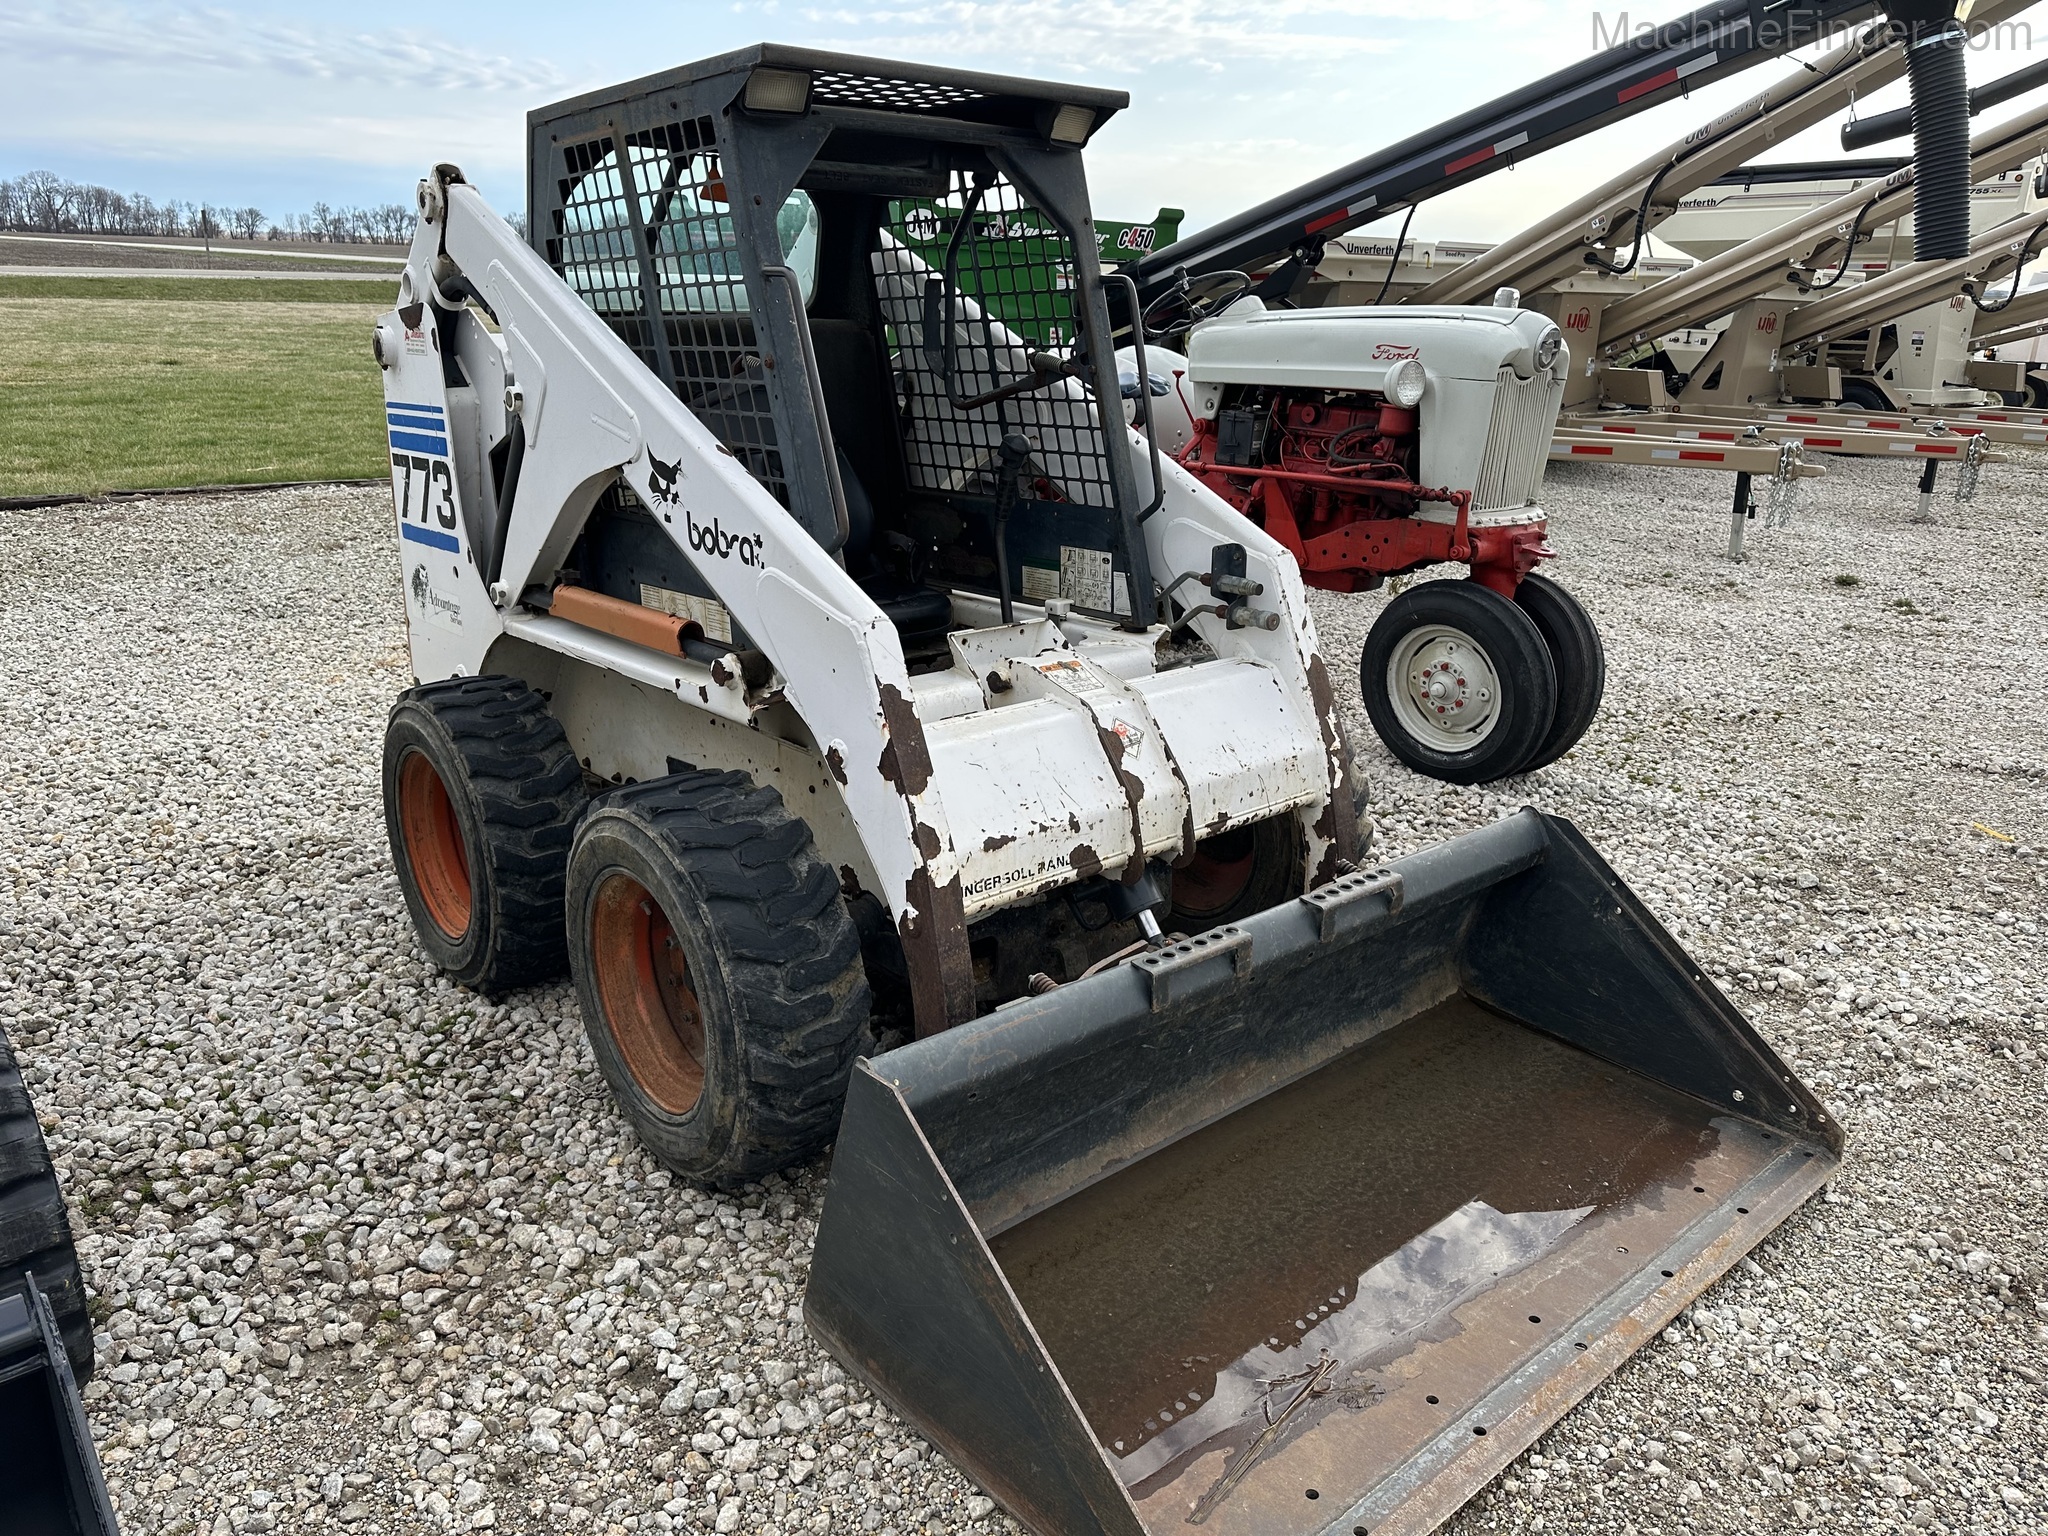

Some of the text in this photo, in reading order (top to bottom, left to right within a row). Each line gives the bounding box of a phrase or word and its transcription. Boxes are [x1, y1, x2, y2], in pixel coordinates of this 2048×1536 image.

[824, 170, 850, 181] BELT
[1678, 198, 1717, 208] verferth
[1118, 227, 1156, 249] C450
[1347, 242, 1395, 255] Unverferth
[1371, 344, 1420, 361] Ford
[391, 452, 457, 530] 773
